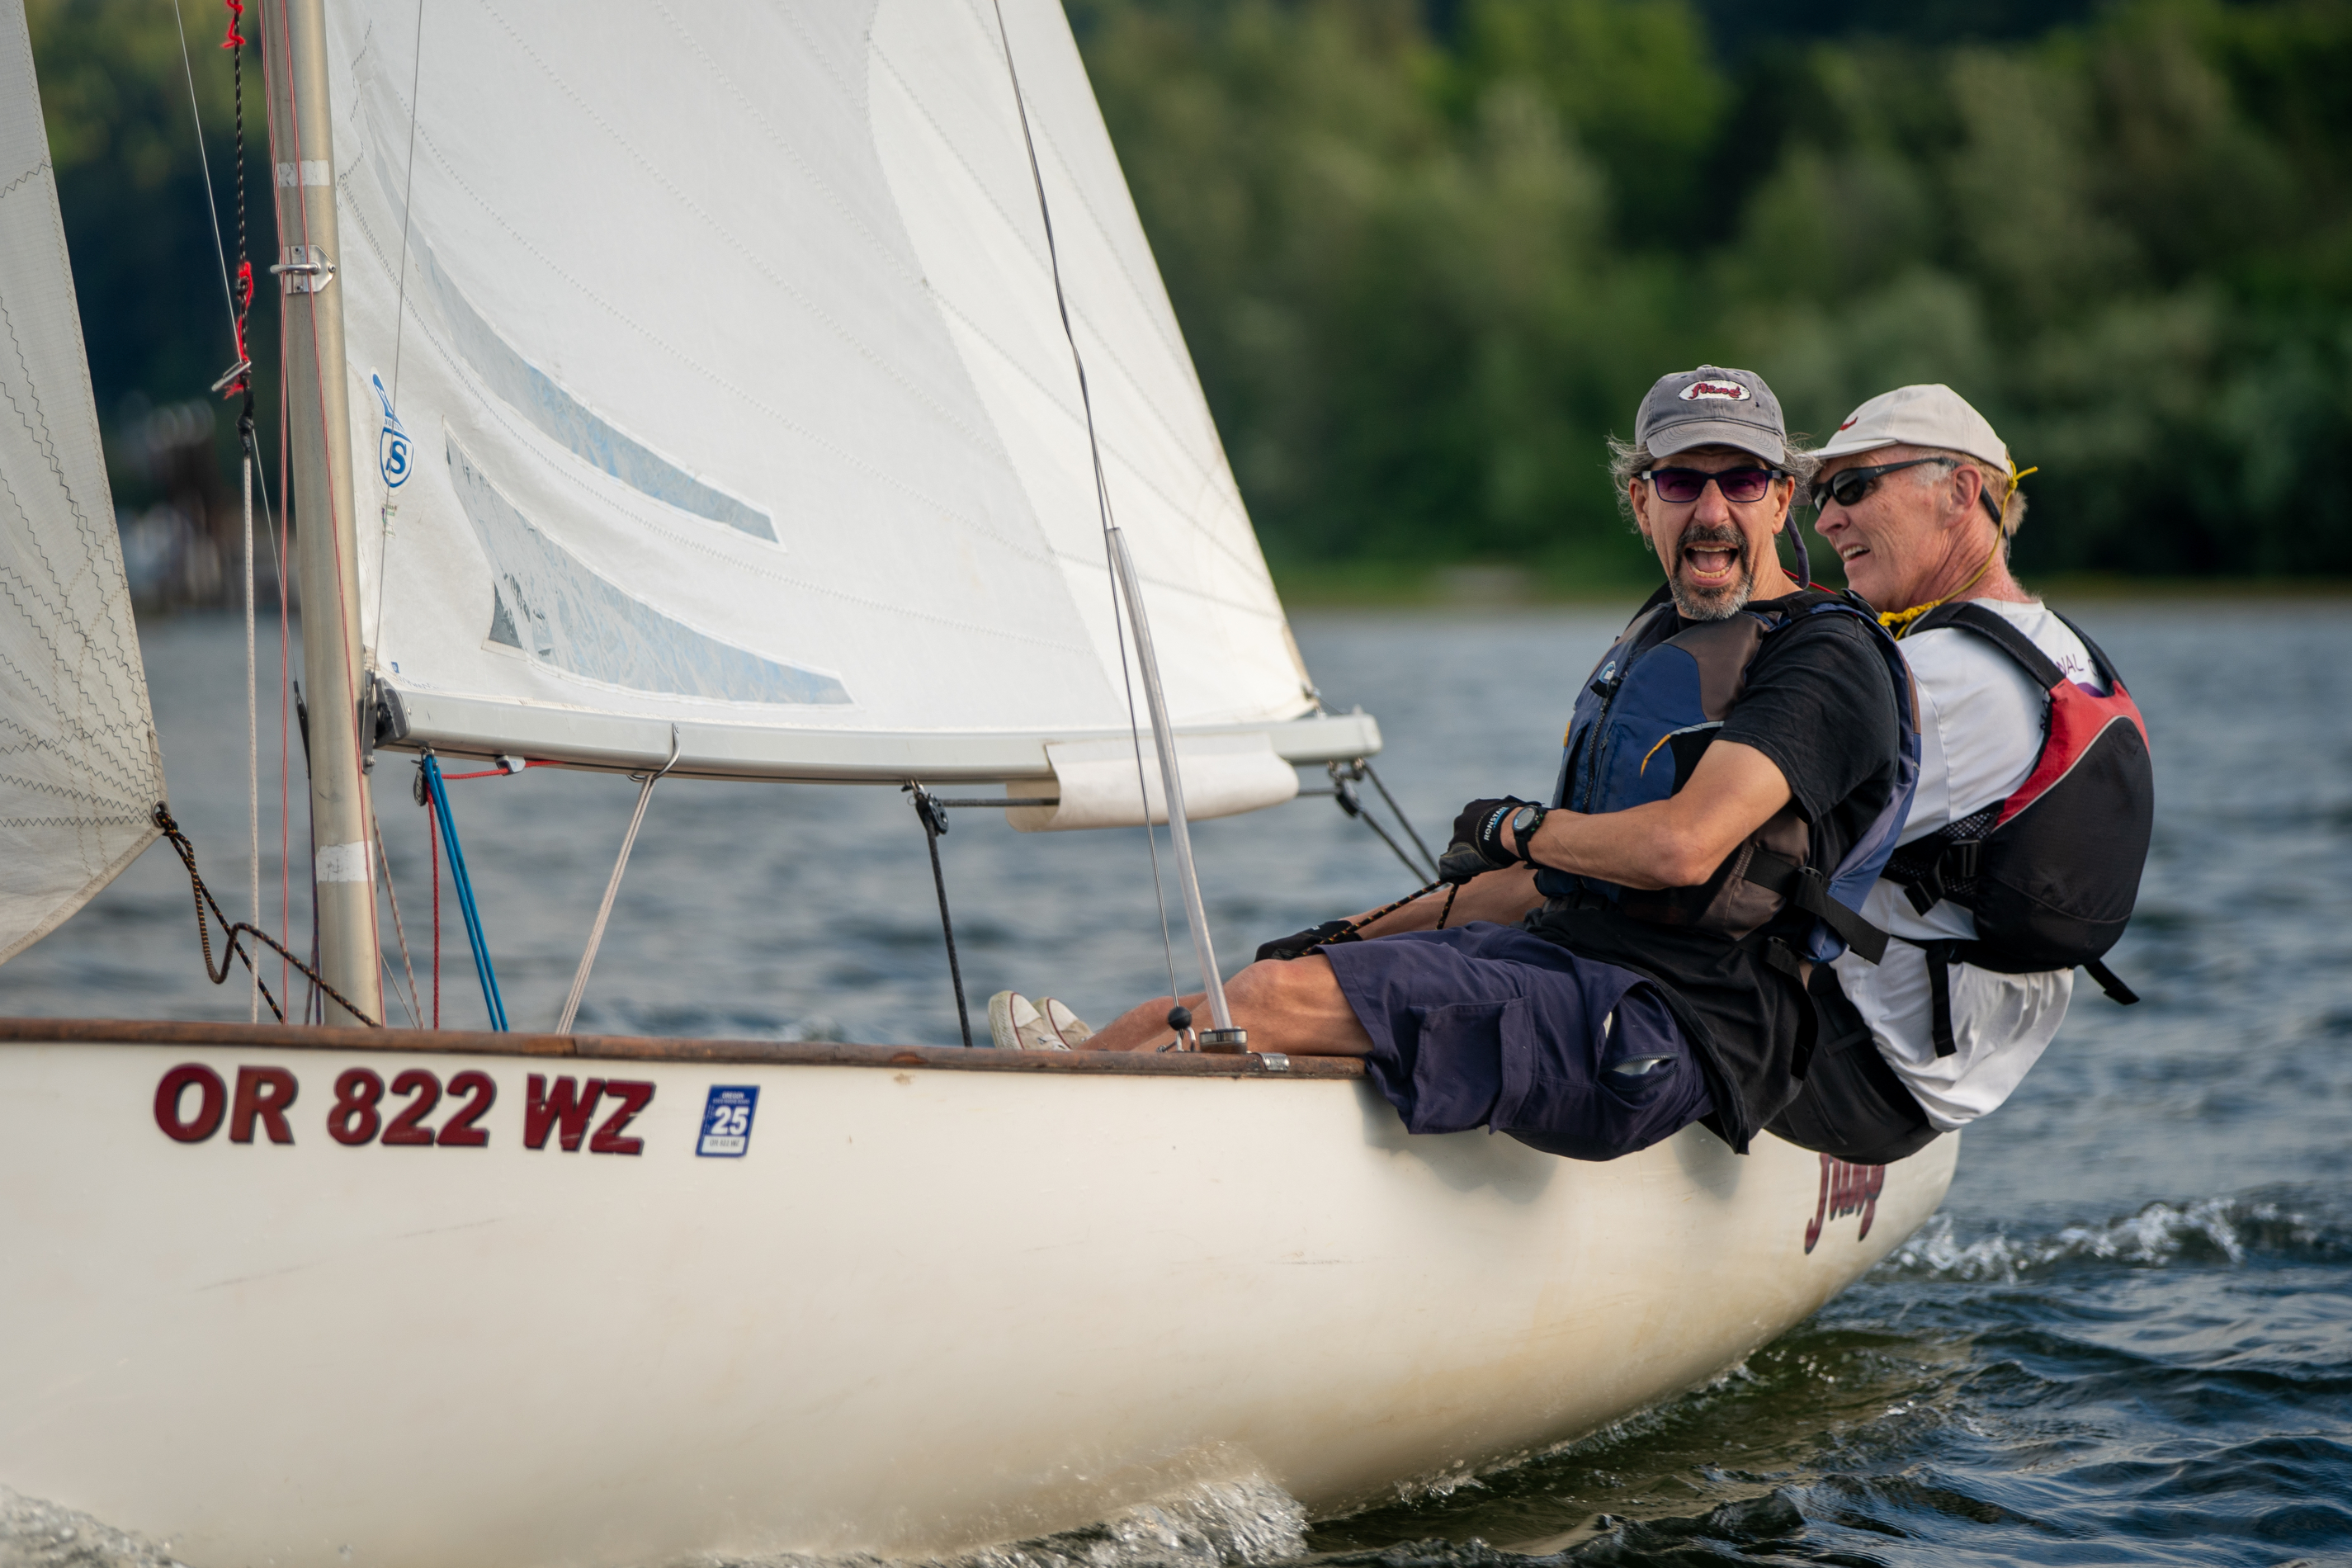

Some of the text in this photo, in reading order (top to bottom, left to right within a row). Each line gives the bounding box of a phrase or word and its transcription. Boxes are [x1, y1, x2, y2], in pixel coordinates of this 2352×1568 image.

[385, 441, 407, 475] S
[153, 1062, 657, 1156] OR 822 WZ
[711, 1105, 749, 1135] 25
